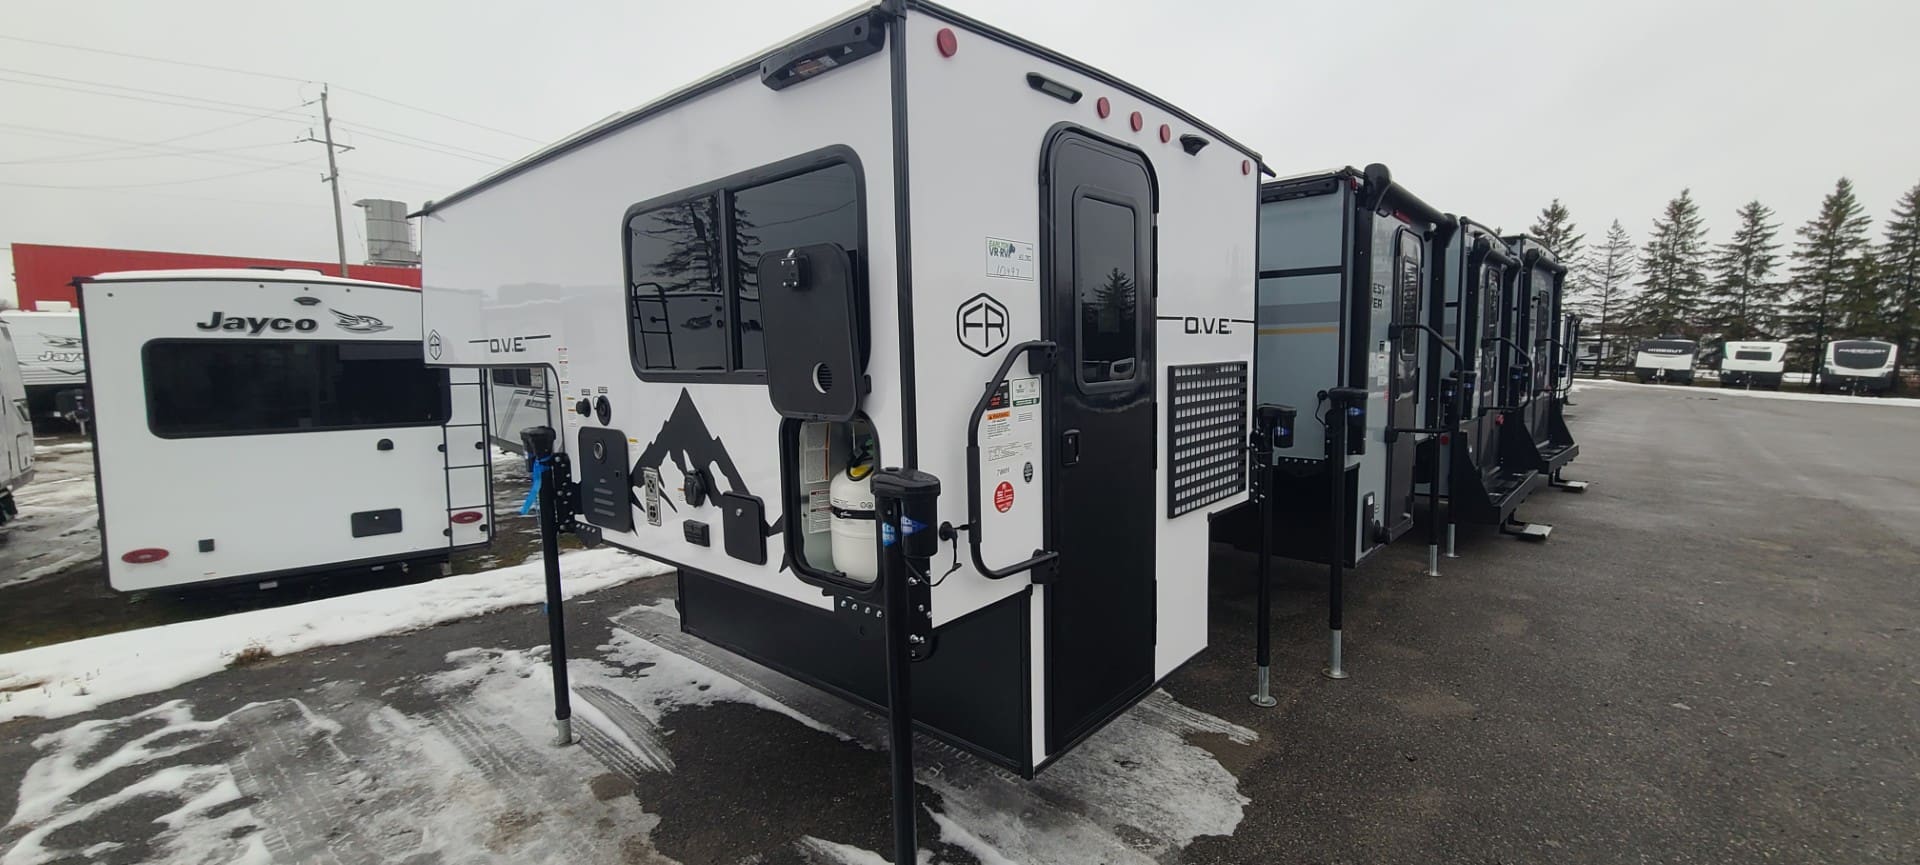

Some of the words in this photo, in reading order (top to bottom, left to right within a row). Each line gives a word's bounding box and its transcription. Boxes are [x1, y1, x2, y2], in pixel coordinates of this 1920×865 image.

[1373, 282, 1385, 295] EST
[1373, 298, 1383, 309] ER
[196, 311, 319, 336] Jayco
[963, 302, 1005, 348] FR
